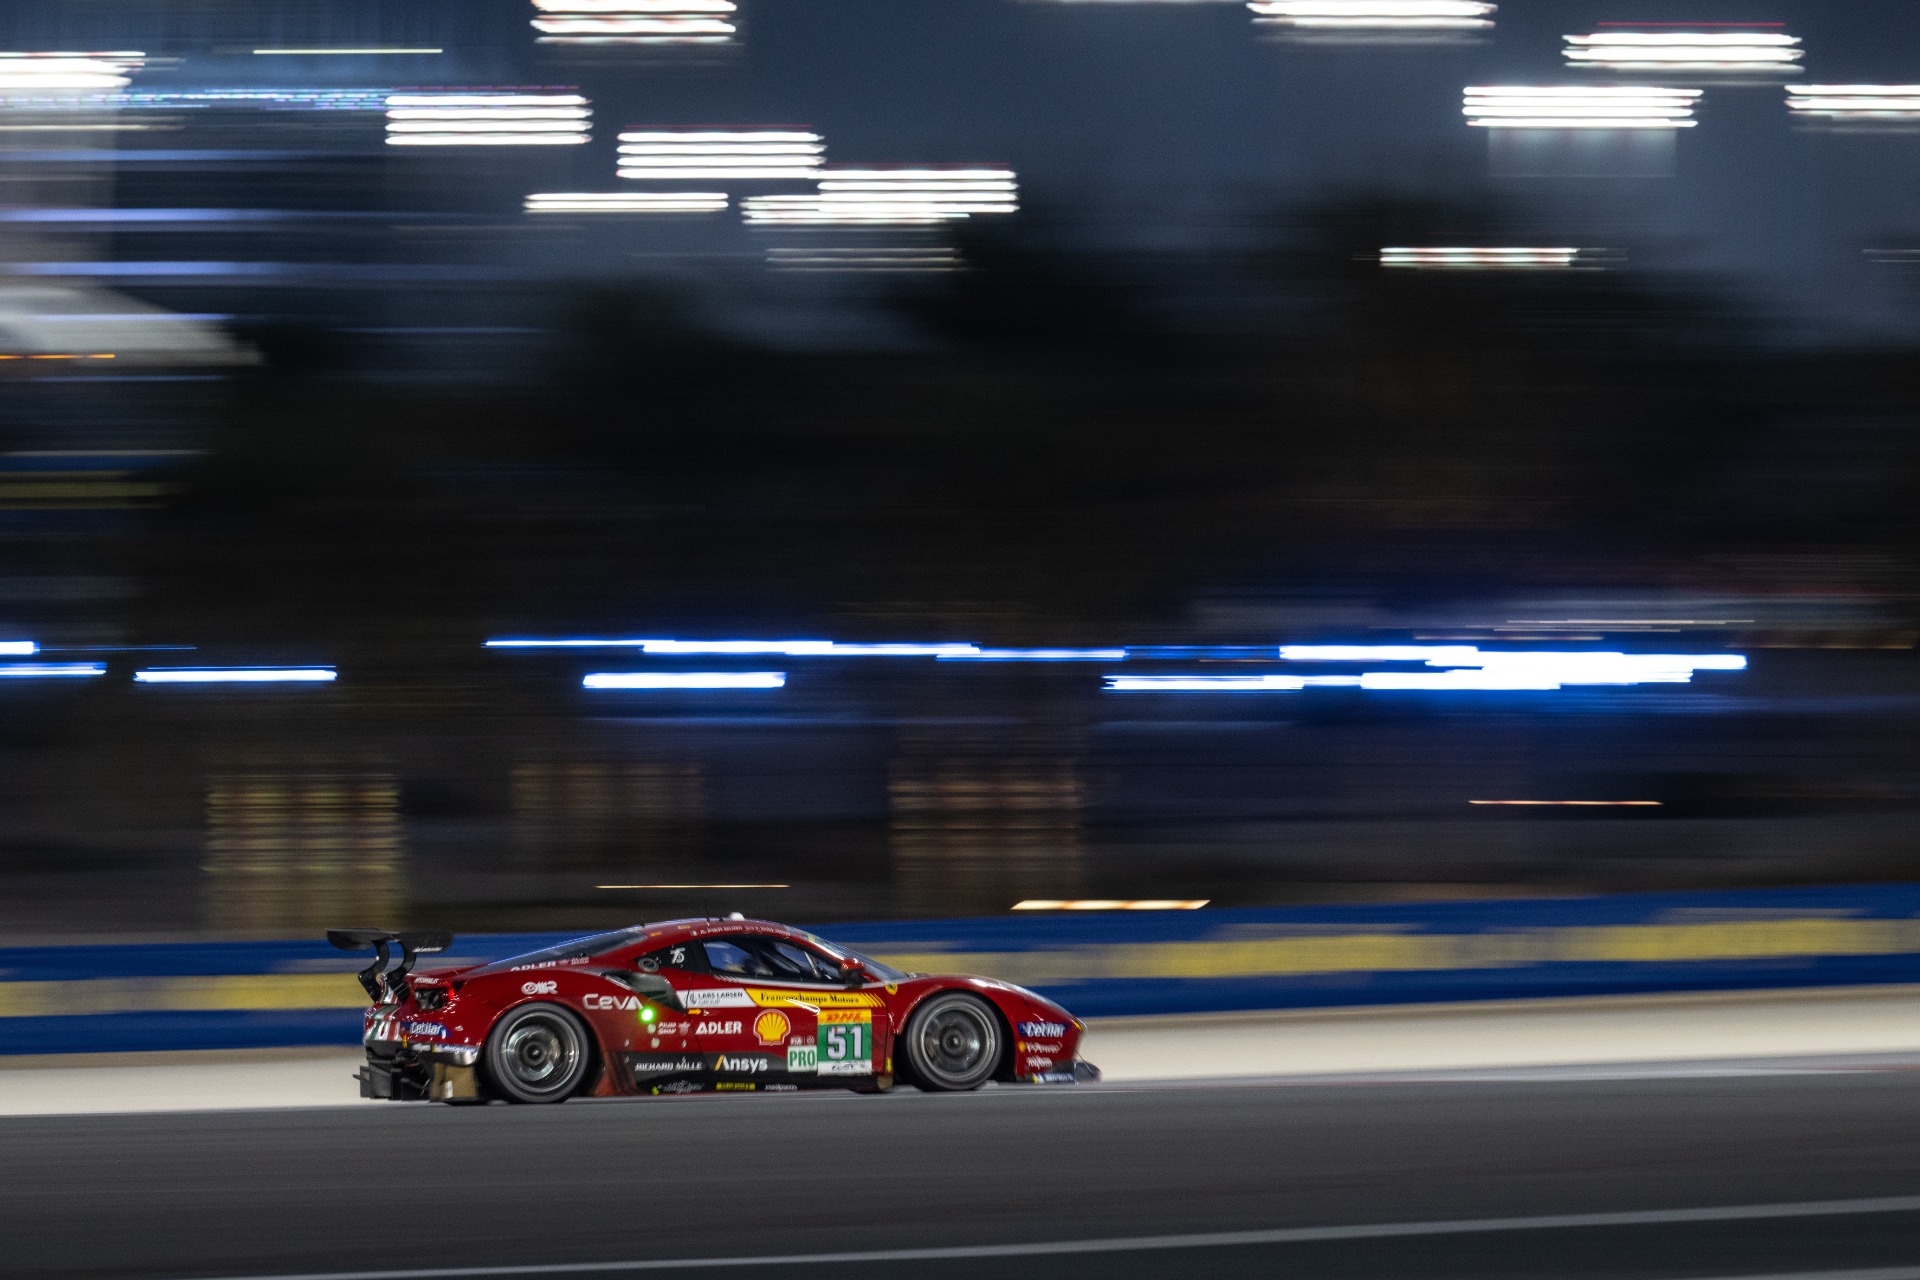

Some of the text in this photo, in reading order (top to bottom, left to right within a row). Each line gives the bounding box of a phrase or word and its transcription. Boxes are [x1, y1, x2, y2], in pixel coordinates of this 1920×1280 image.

[510, 961, 556, 971] ADLER
[760, 992, 828, 1003] Francorchamps
[826, 1012, 862, 1021] DHL
[410, 1022, 443, 1034] Cetilar
[695, 1021, 742, 1035] ADLER
[827, 1025, 862, 1060] 51
[714, 1055, 768, 1074] Ansys
[789, 1050, 816, 1067] PRO
[635, 1061, 702, 1071] RICHARD MILLE
